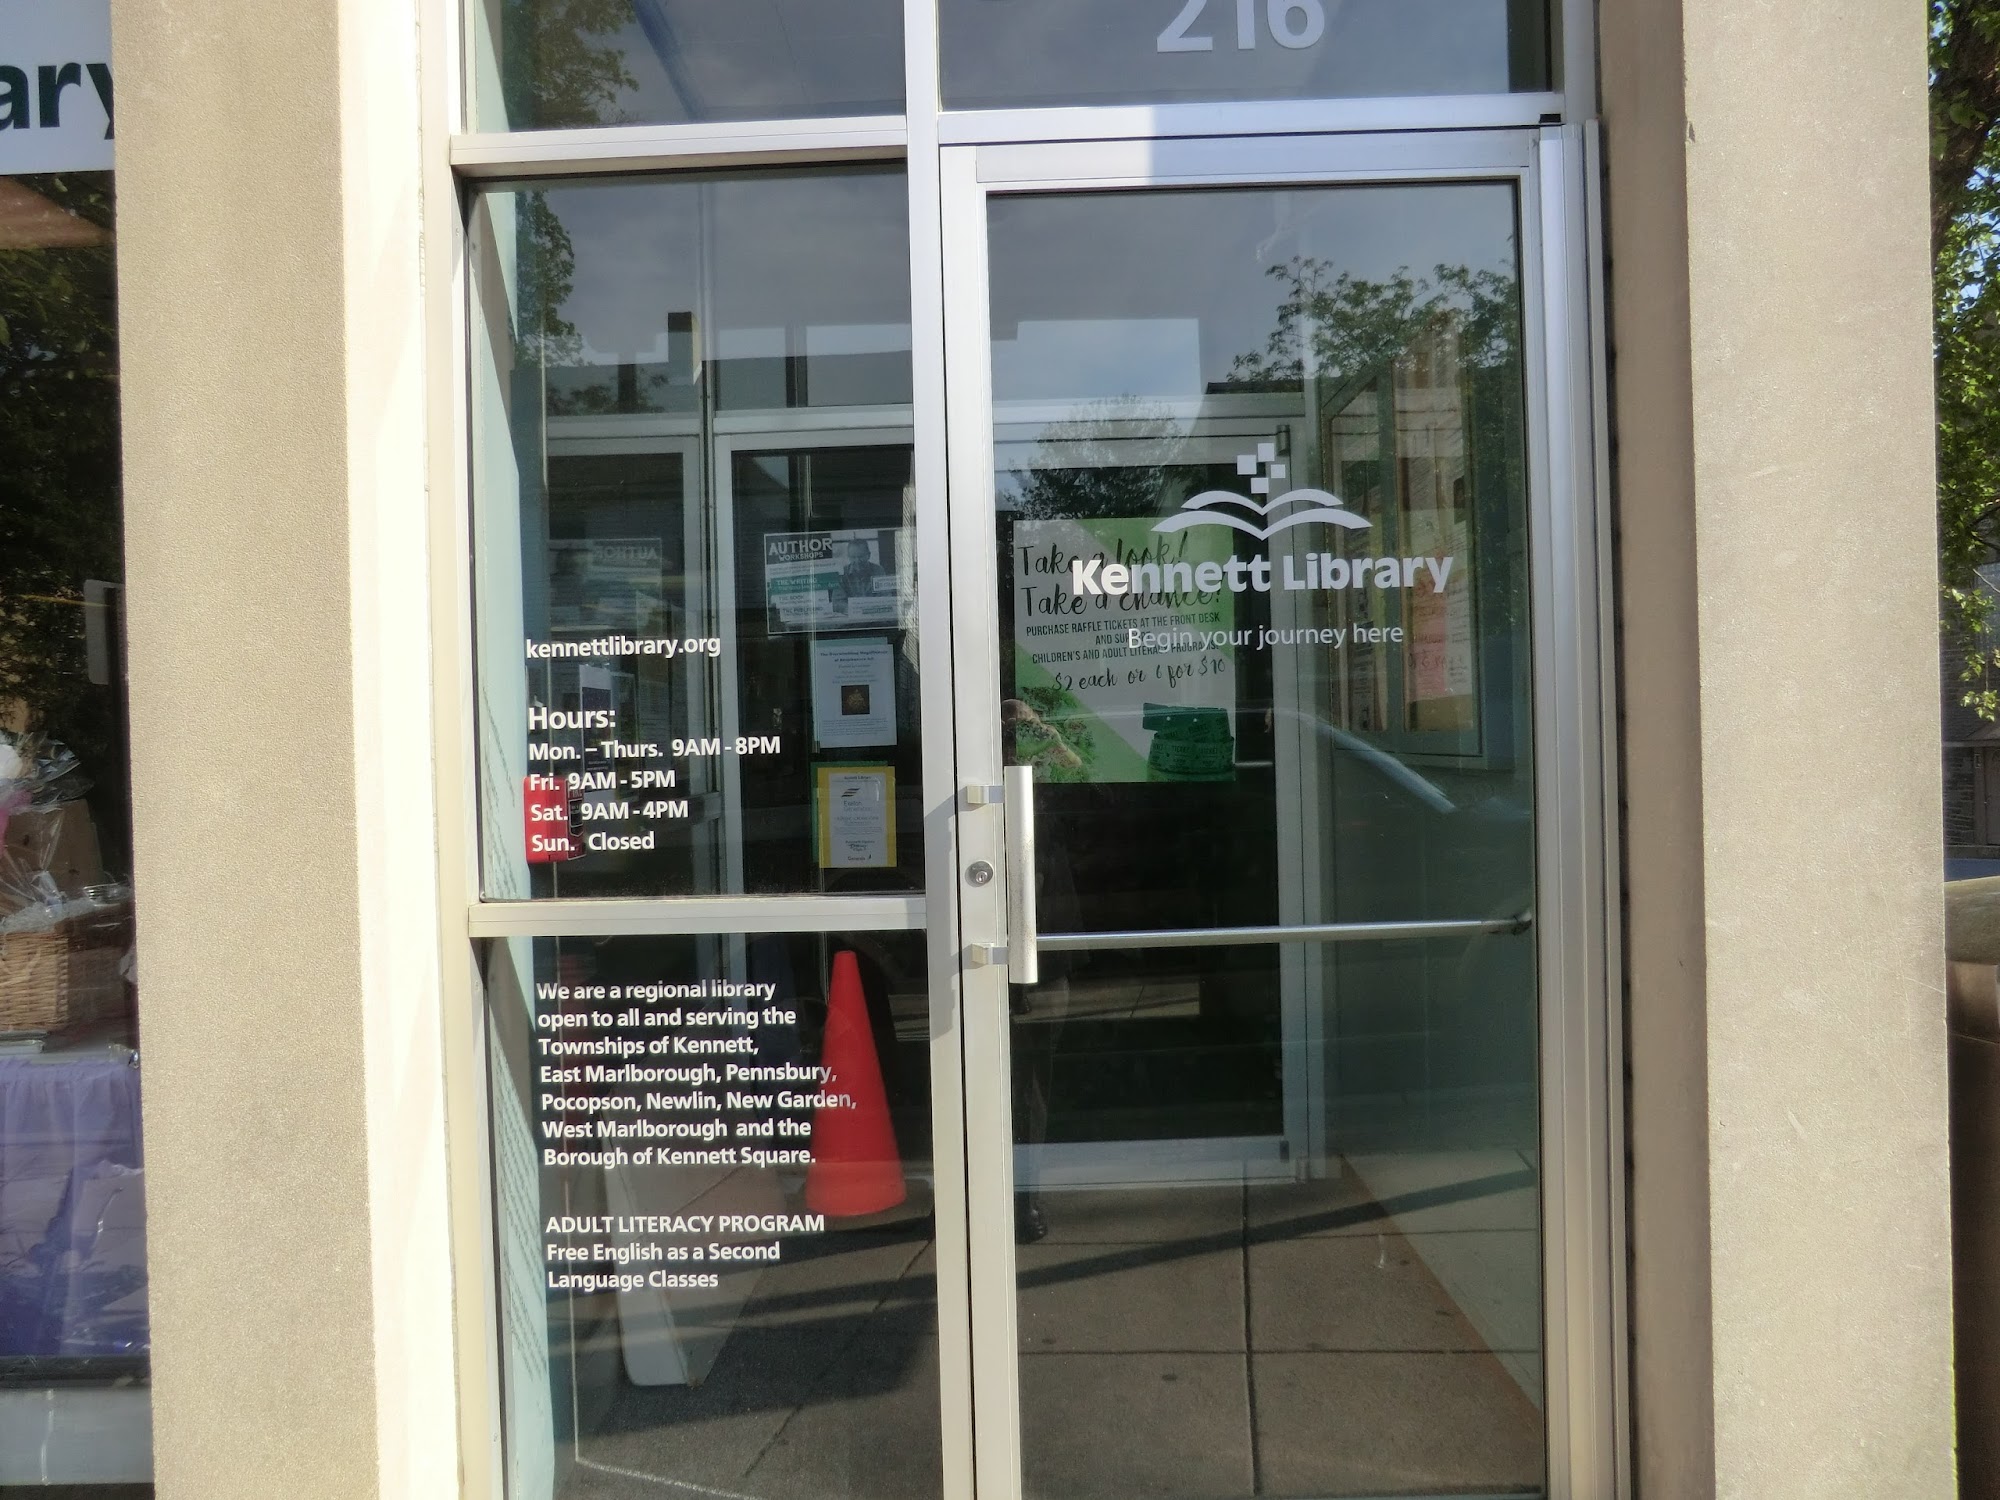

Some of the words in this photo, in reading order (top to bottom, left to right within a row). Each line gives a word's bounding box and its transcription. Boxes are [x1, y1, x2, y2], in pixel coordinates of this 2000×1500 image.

[1157, 0, 1325, 52] 216
[769, 538, 832, 556] AUTHOR
[779, 552, 824, 561] WORKSHOPS
[1072, 554, 1271, 597] Kennett
[1283, 552, 1454, 593] Library
[1020, 583, 1087, 616] Take
[1095, 593, 1110, 610] a
[1026, 622, 1070, 636] PURCHASE
[1071, 621, 1102, 634] RAFFLE
[1103, 618, 1138, 631] TICKETS
[1140, 618, 1151, 629] AT
[1151, 616, 1168, 627] THE
[1169, 613, 1197, 626] FRONT
[1198, 611, 1220, 623] DESK
[526, 634, 721, 660] kennettlibrary.org
[1095, 634, 1113, 645] AND
[1128, 625, 1195, 654] Begin
[1199, 628, 1251, 654] your
[1256, 624, 1348, 651] journey
[1352, 622, 1404, 644] here
[1032, 650, 1081, 664] CHILDREN'S
[1082, 648, 1100, 660] AND
[1102, 646, 1128, 658] ADULT
[1052, 673, 1073, 691] $2
[1079, 668, 1118, 689] each
[1128, 669, 1146, 684] or
[1167, 662, 1195, 688] for
[528, 706, 617, 731] Hours:
[529, 742, 581, 761] Mon.
[601, 739, 664, 758] Thurs.
[530, 772, 560, 791] Fri.
[530, 803, 568, 821] Sat.
[532, 833, 576, 852] Sun.
[588, 831, 655, 851] Closed
[536, 983, 570, 999] We
[574, 986, 605, 999] are
[609, 986, 621, 999] a
[625, 980, 707, 1003] regional
[711, 979, 776, 1000] library
[538, 1011, 588, 1031] open
[591, 1010, 613, 1026] to
[617, 1008, 640, 1026] all
[644, 1007, 682, 1026] and
[686, 1008, 759, 1029] serving
[762, 1006, 796, 1024] the
[539, 1037, 645, 1058] Townships
[649, 1036, 669, 1054] of
[673, 1036, 759, 1056] Kennett,
[541, 1066, 581, 1083] East
[585, 1064, 721, 1085] Marlborough,
[726, 1063, 837, 1084] Pennsbury,
[542, 1094, 642, 1114] Pocopson,
[646, 1092, 722, 1111] Newlin,
[727, 1092, 773, 1109] New
[777, 1091, 857, 1110] Garden,
[542, 1122, 593, 1139] West
[597, 1120, 728, 1141] Marlborough
[736, 1119, 774, 1137] and
[777, 1118, 811, 1136] the
[544, 1149, 628, 1169] Borough
[632, 1147, 653, 1165] of
[657, 1147, 737, 1165] Kennett
[741, 1147, 816, 1168] Square.
[545, 1216, 614, 1234] ADULT
[618, 1215, 715, 1233] LITERACY
[719, 1214, 825, 1232] PROGRAM
[547, 1243, 589, 1261] Free
[593, 1243, 662, 1264] English
[666, 1246, 689, 1260] as
[692, 1246, 704, 1260] a
[709, 1241, 780, 1260] Second
[547, 1271, 644, 1291] Language
[649, 1270, 719, 1288] Classes
